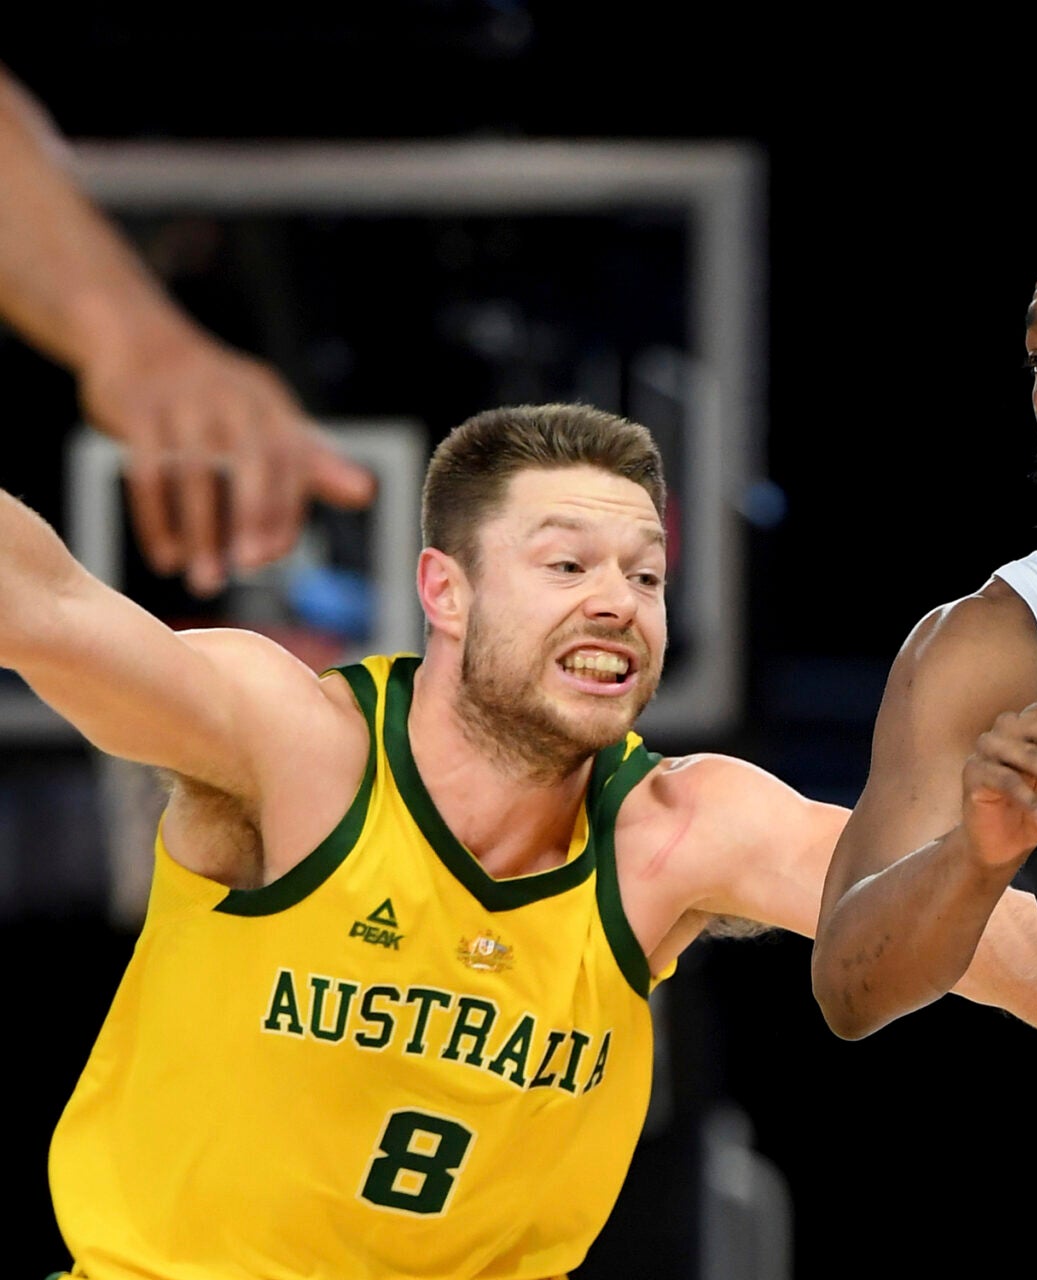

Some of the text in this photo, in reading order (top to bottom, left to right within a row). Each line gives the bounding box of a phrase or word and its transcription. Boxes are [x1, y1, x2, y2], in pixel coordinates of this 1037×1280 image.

[349, 920, 404, 951] PEAK
[263, 969, 613, 1096] AUSTRALIA
[357, 1106, 476, 1216] 8
